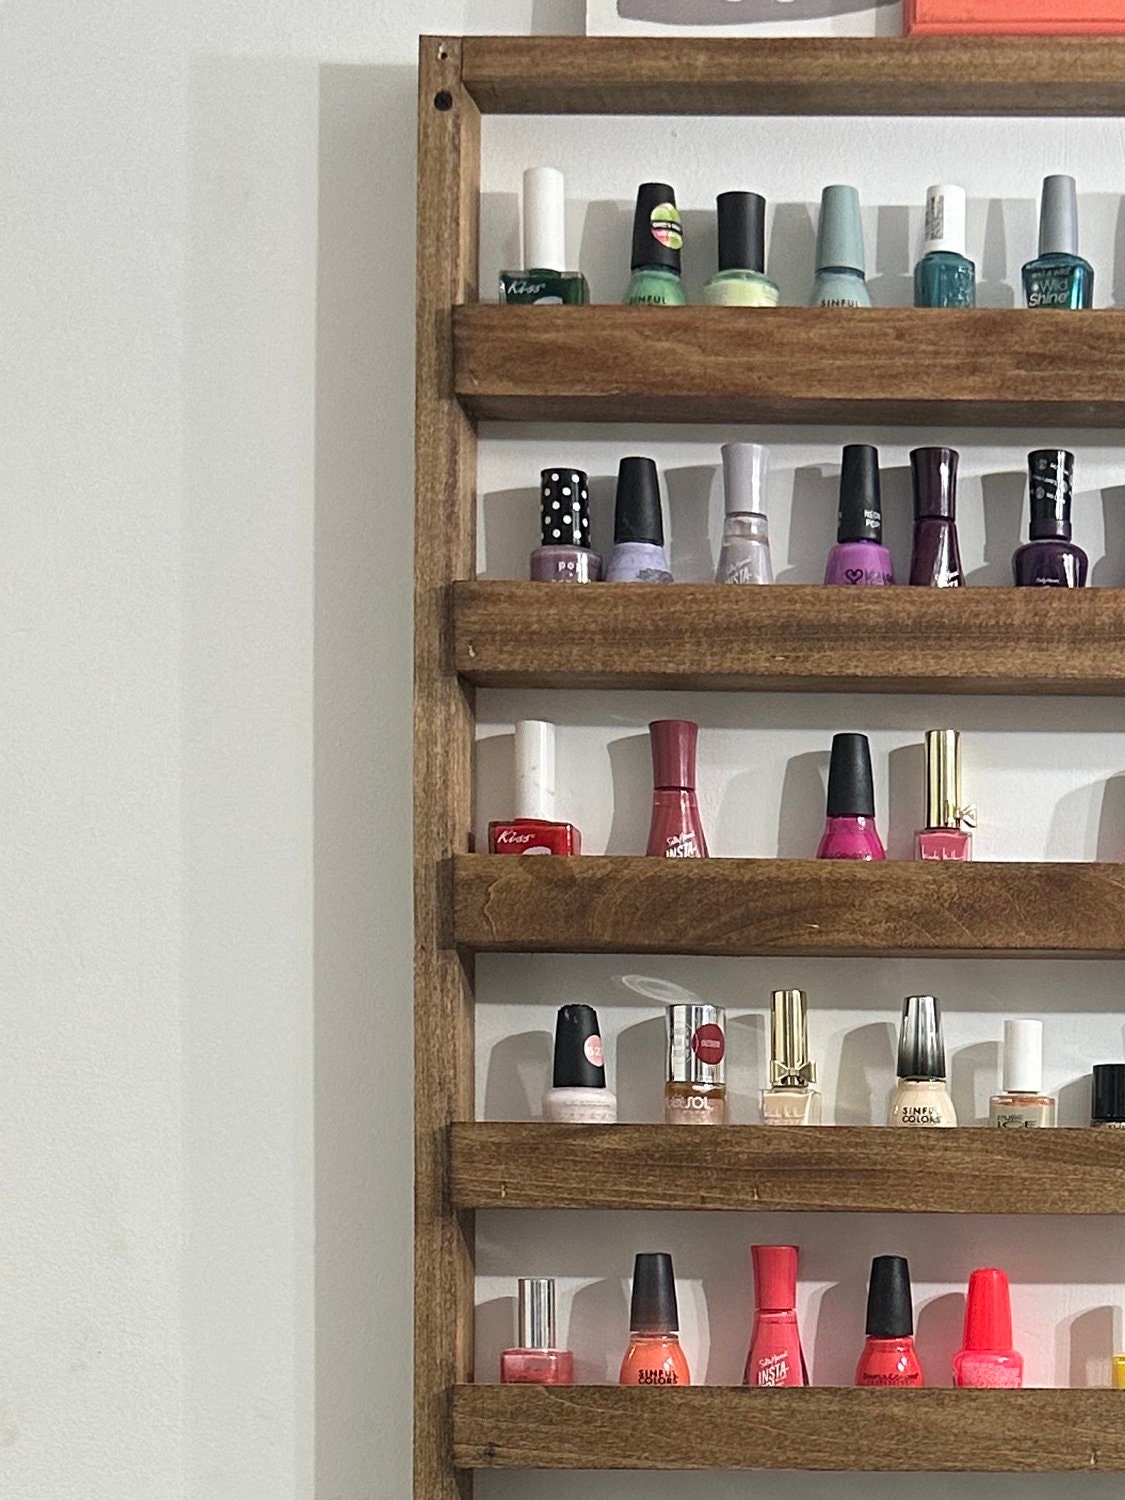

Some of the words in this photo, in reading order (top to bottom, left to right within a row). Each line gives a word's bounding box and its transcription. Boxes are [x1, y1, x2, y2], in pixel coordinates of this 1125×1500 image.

[1040, 279, 1068, 292] Wild
[1028, 291, 1069, 308] Shine
[497, 829, 531, 844] Kiss
[902, 1106, 939, 1115] SINFU
